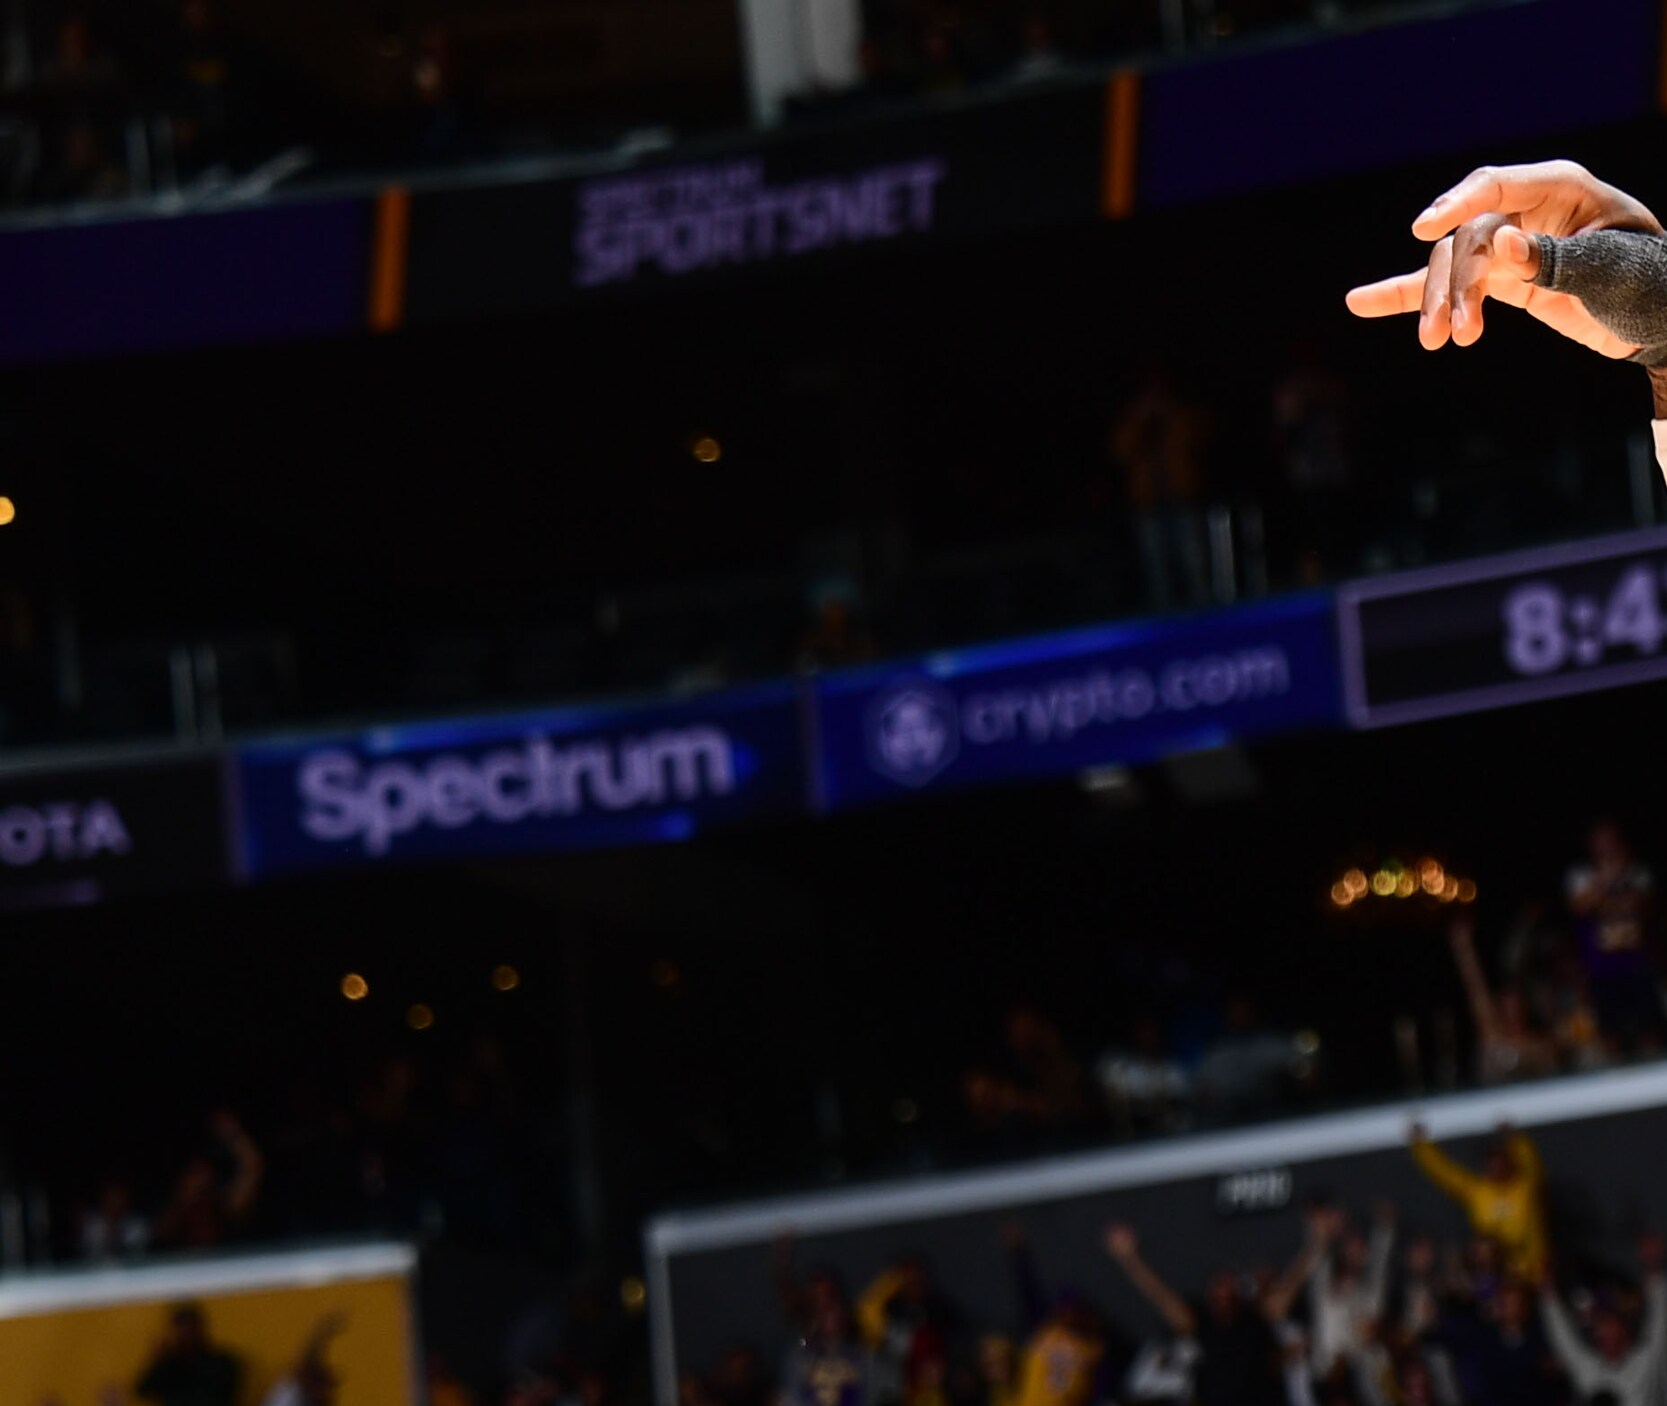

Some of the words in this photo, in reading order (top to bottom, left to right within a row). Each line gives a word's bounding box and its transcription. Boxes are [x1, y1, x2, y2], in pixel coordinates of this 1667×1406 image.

[572, 155, 948, 287] SPORTSNET
[961, 642, 1290, 744] crypto.com
[296, 725, 736, 854] Spectrum
